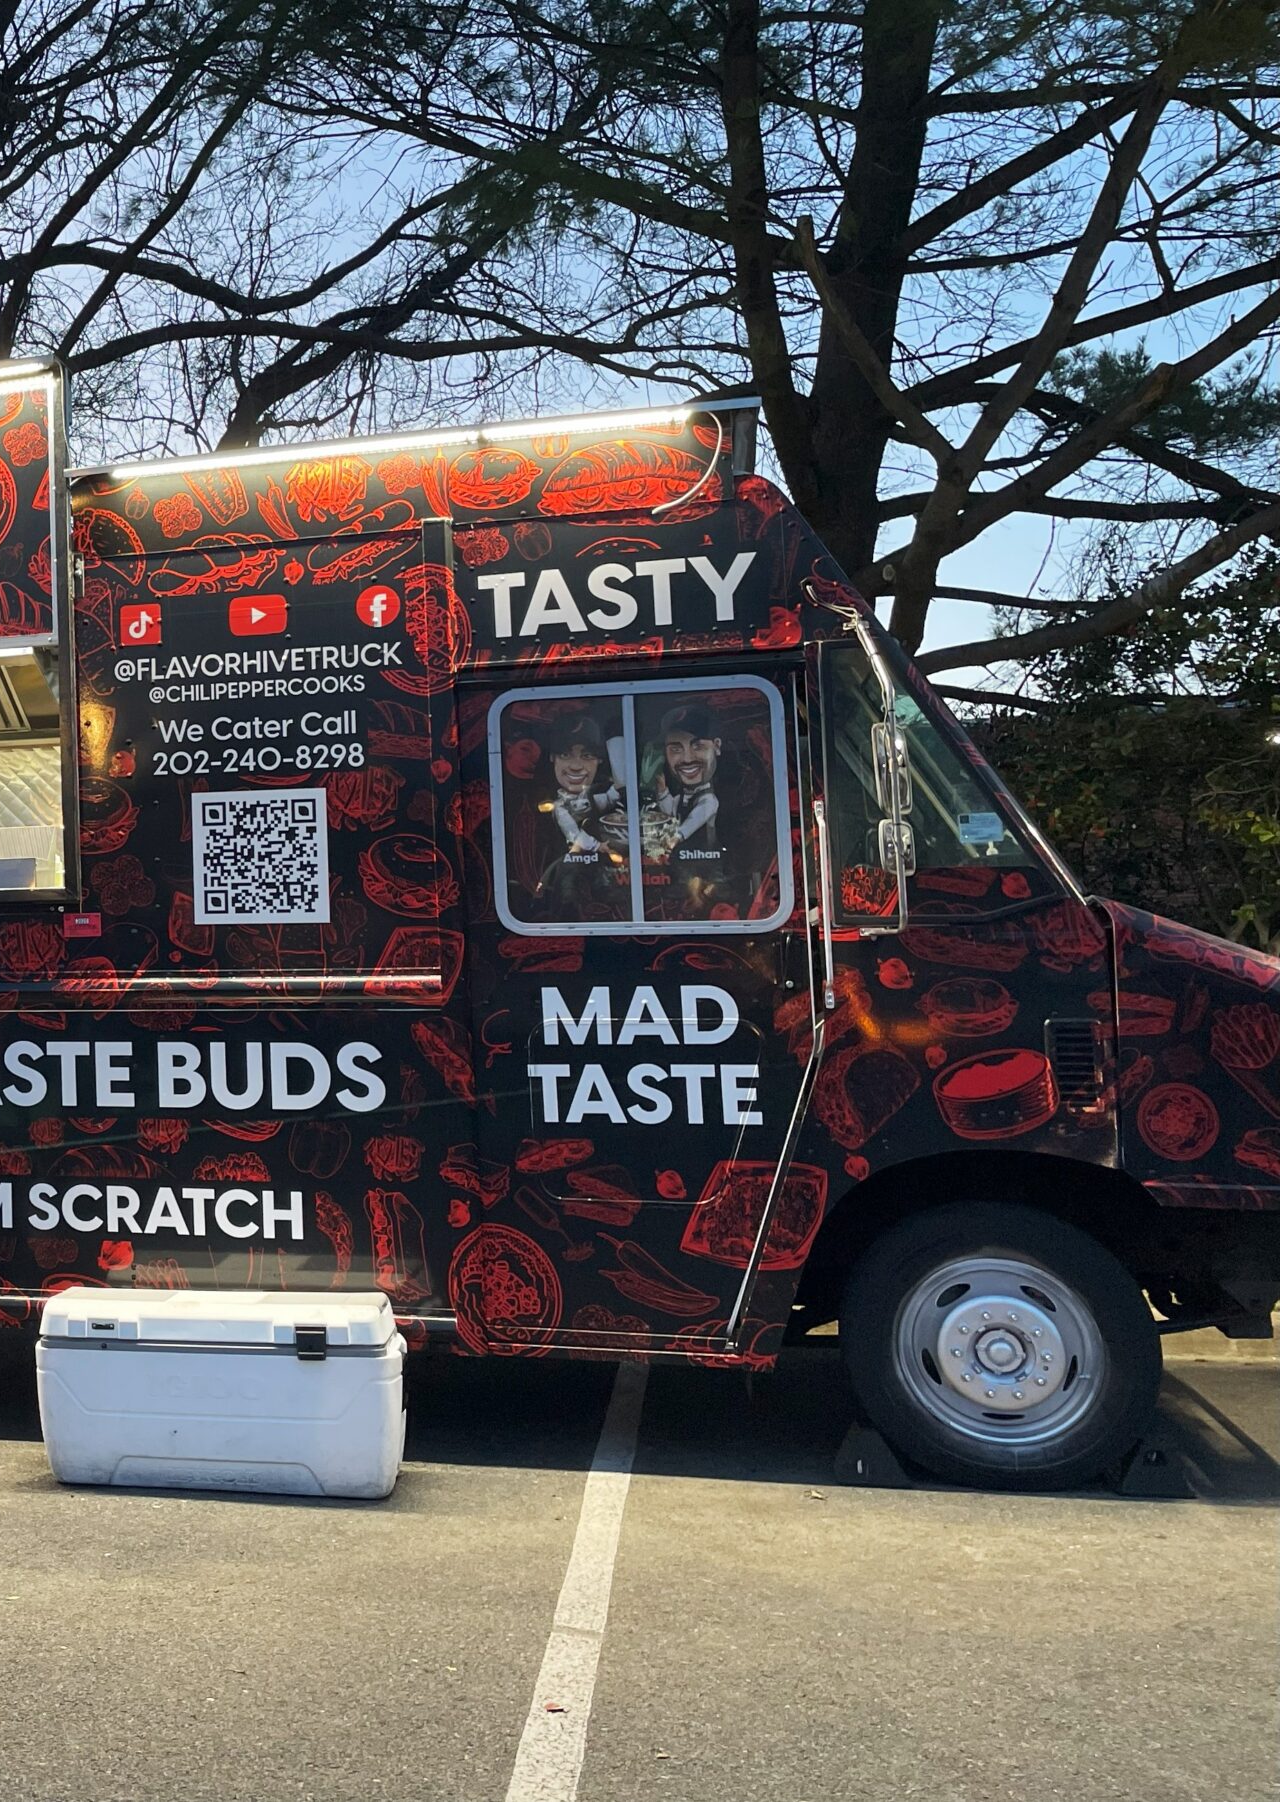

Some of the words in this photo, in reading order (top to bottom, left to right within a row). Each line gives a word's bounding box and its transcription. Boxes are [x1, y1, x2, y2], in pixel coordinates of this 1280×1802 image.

[477, 551, 757, 638] TASTY
[114, 641, 403, 682] @FLAVORHIVETRUCK
[148, 674, 366, 704] @CHILIPEPPERCOOKS
[158, 719, 204, 743] We
[210, 715, 294, 742] Cater
[300, 710, 358, 737] Call
[153, 743, 365, 776] 202-240-8298
[563, 853, 599, 865] Amgd
[679, 850, 721, 860] Shihan
[541, 984, 739, 1045] MAD
[157, 1041, 387, 1113] BUDS
[528, 1063, 763, 1125] TASTE
[28, 1182, 304, 1239] SCRATCH
